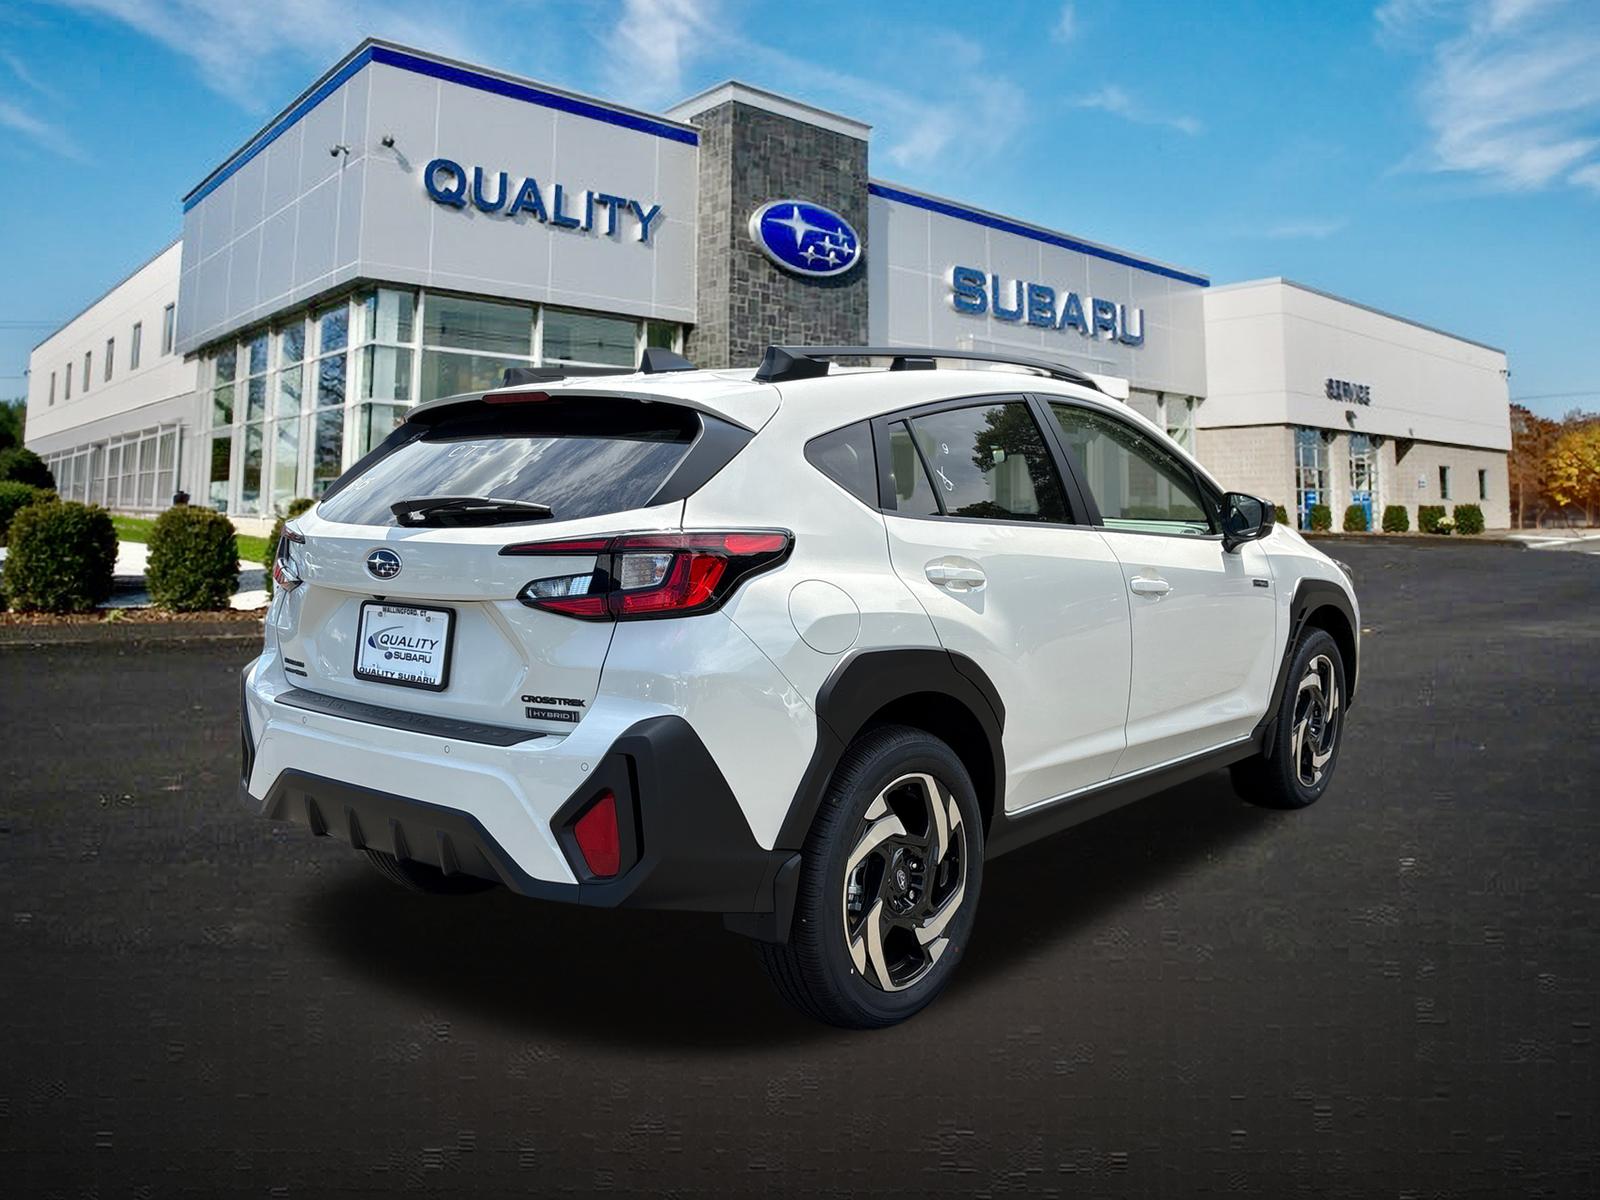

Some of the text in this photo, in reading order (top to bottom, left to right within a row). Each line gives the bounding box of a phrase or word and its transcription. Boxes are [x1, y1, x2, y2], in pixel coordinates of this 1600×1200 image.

[423, 158, 661, 243] QUALITY
[951, 265, 1145, 346] SUBARU
[380, 633, 439, 651] QUALITY
[393, 651, 432, 664] SUBARU
[359, 666, 436, 685] QUALITY SUBARU
[521, 695, 586, 708] CROSSTREK
[533, 710, 570, 720] HYBRID
